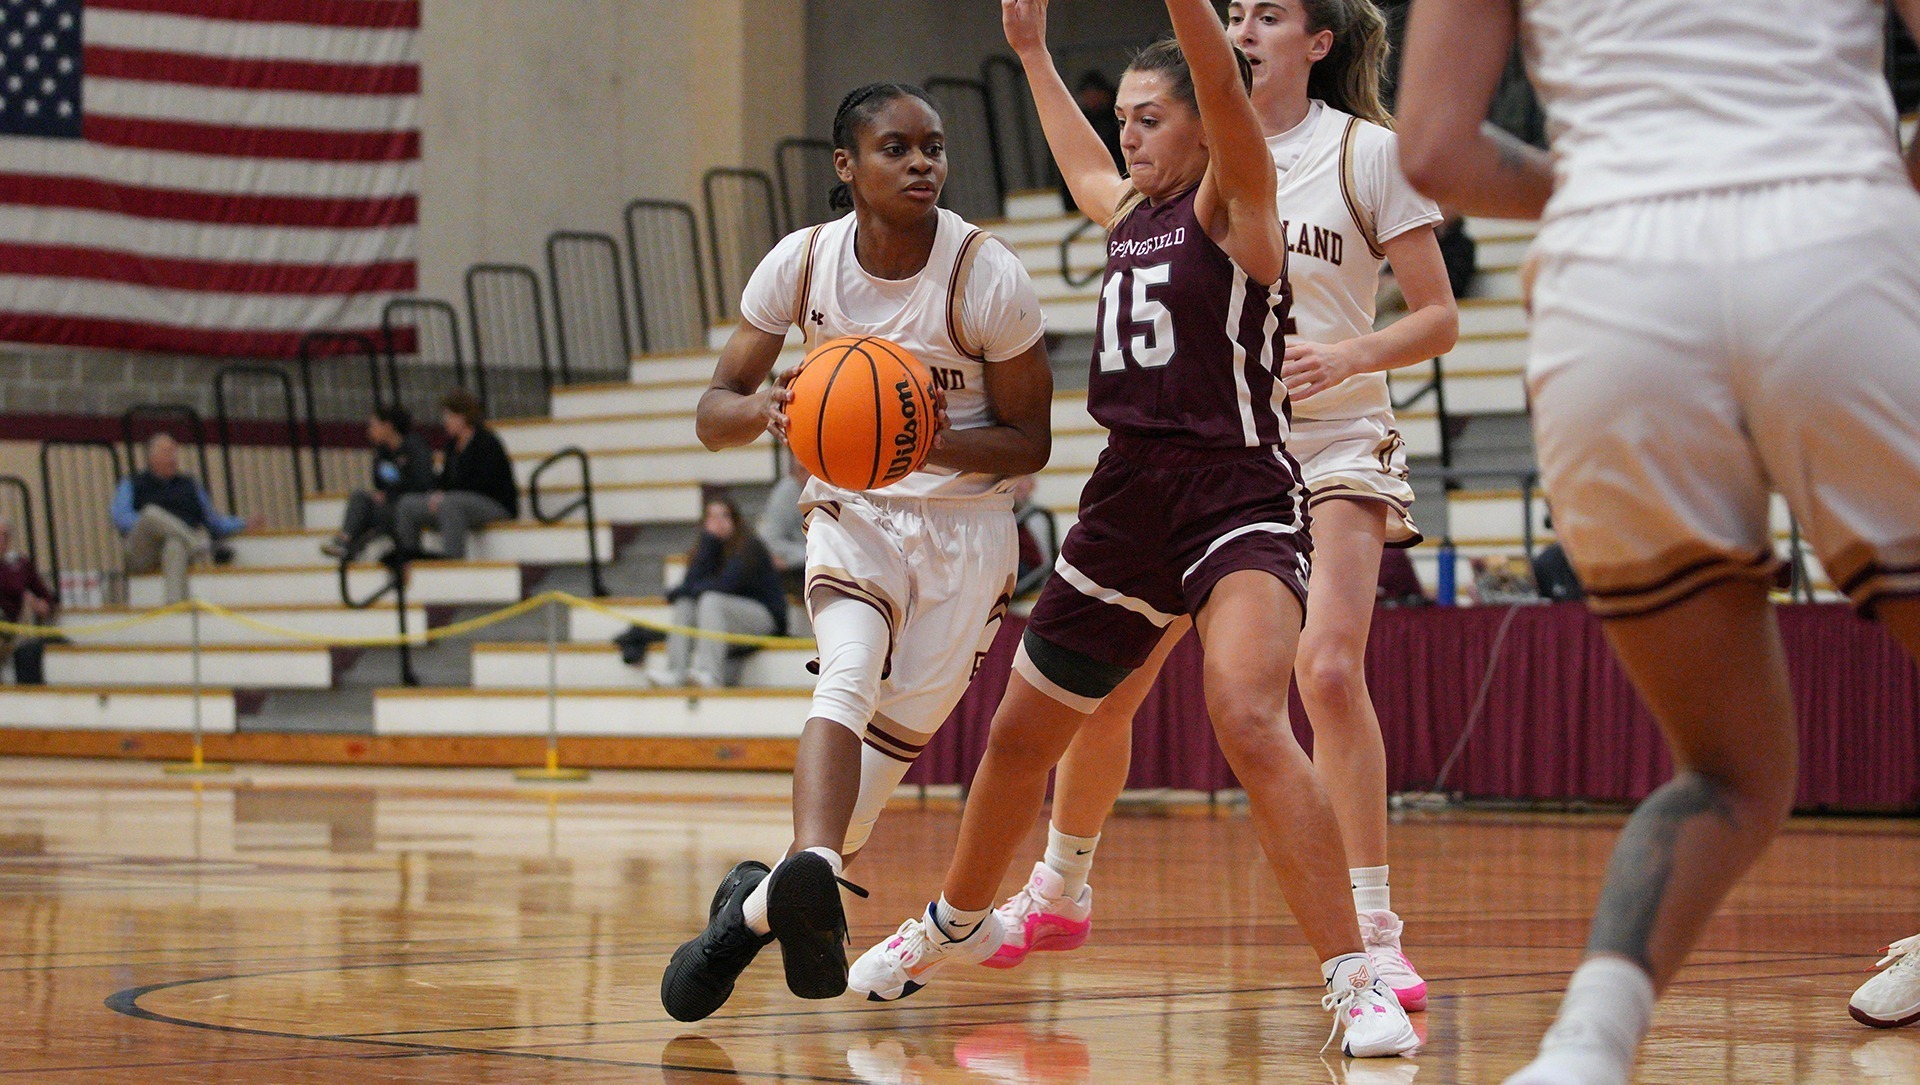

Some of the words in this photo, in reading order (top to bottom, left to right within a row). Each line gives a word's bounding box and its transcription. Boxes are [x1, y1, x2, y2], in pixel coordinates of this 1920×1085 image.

[1110, 226, 1185, 258] SPINGFIELD
[1099, 262, 1177, 373] 15
[882, 378, 918, 481] Wilson
